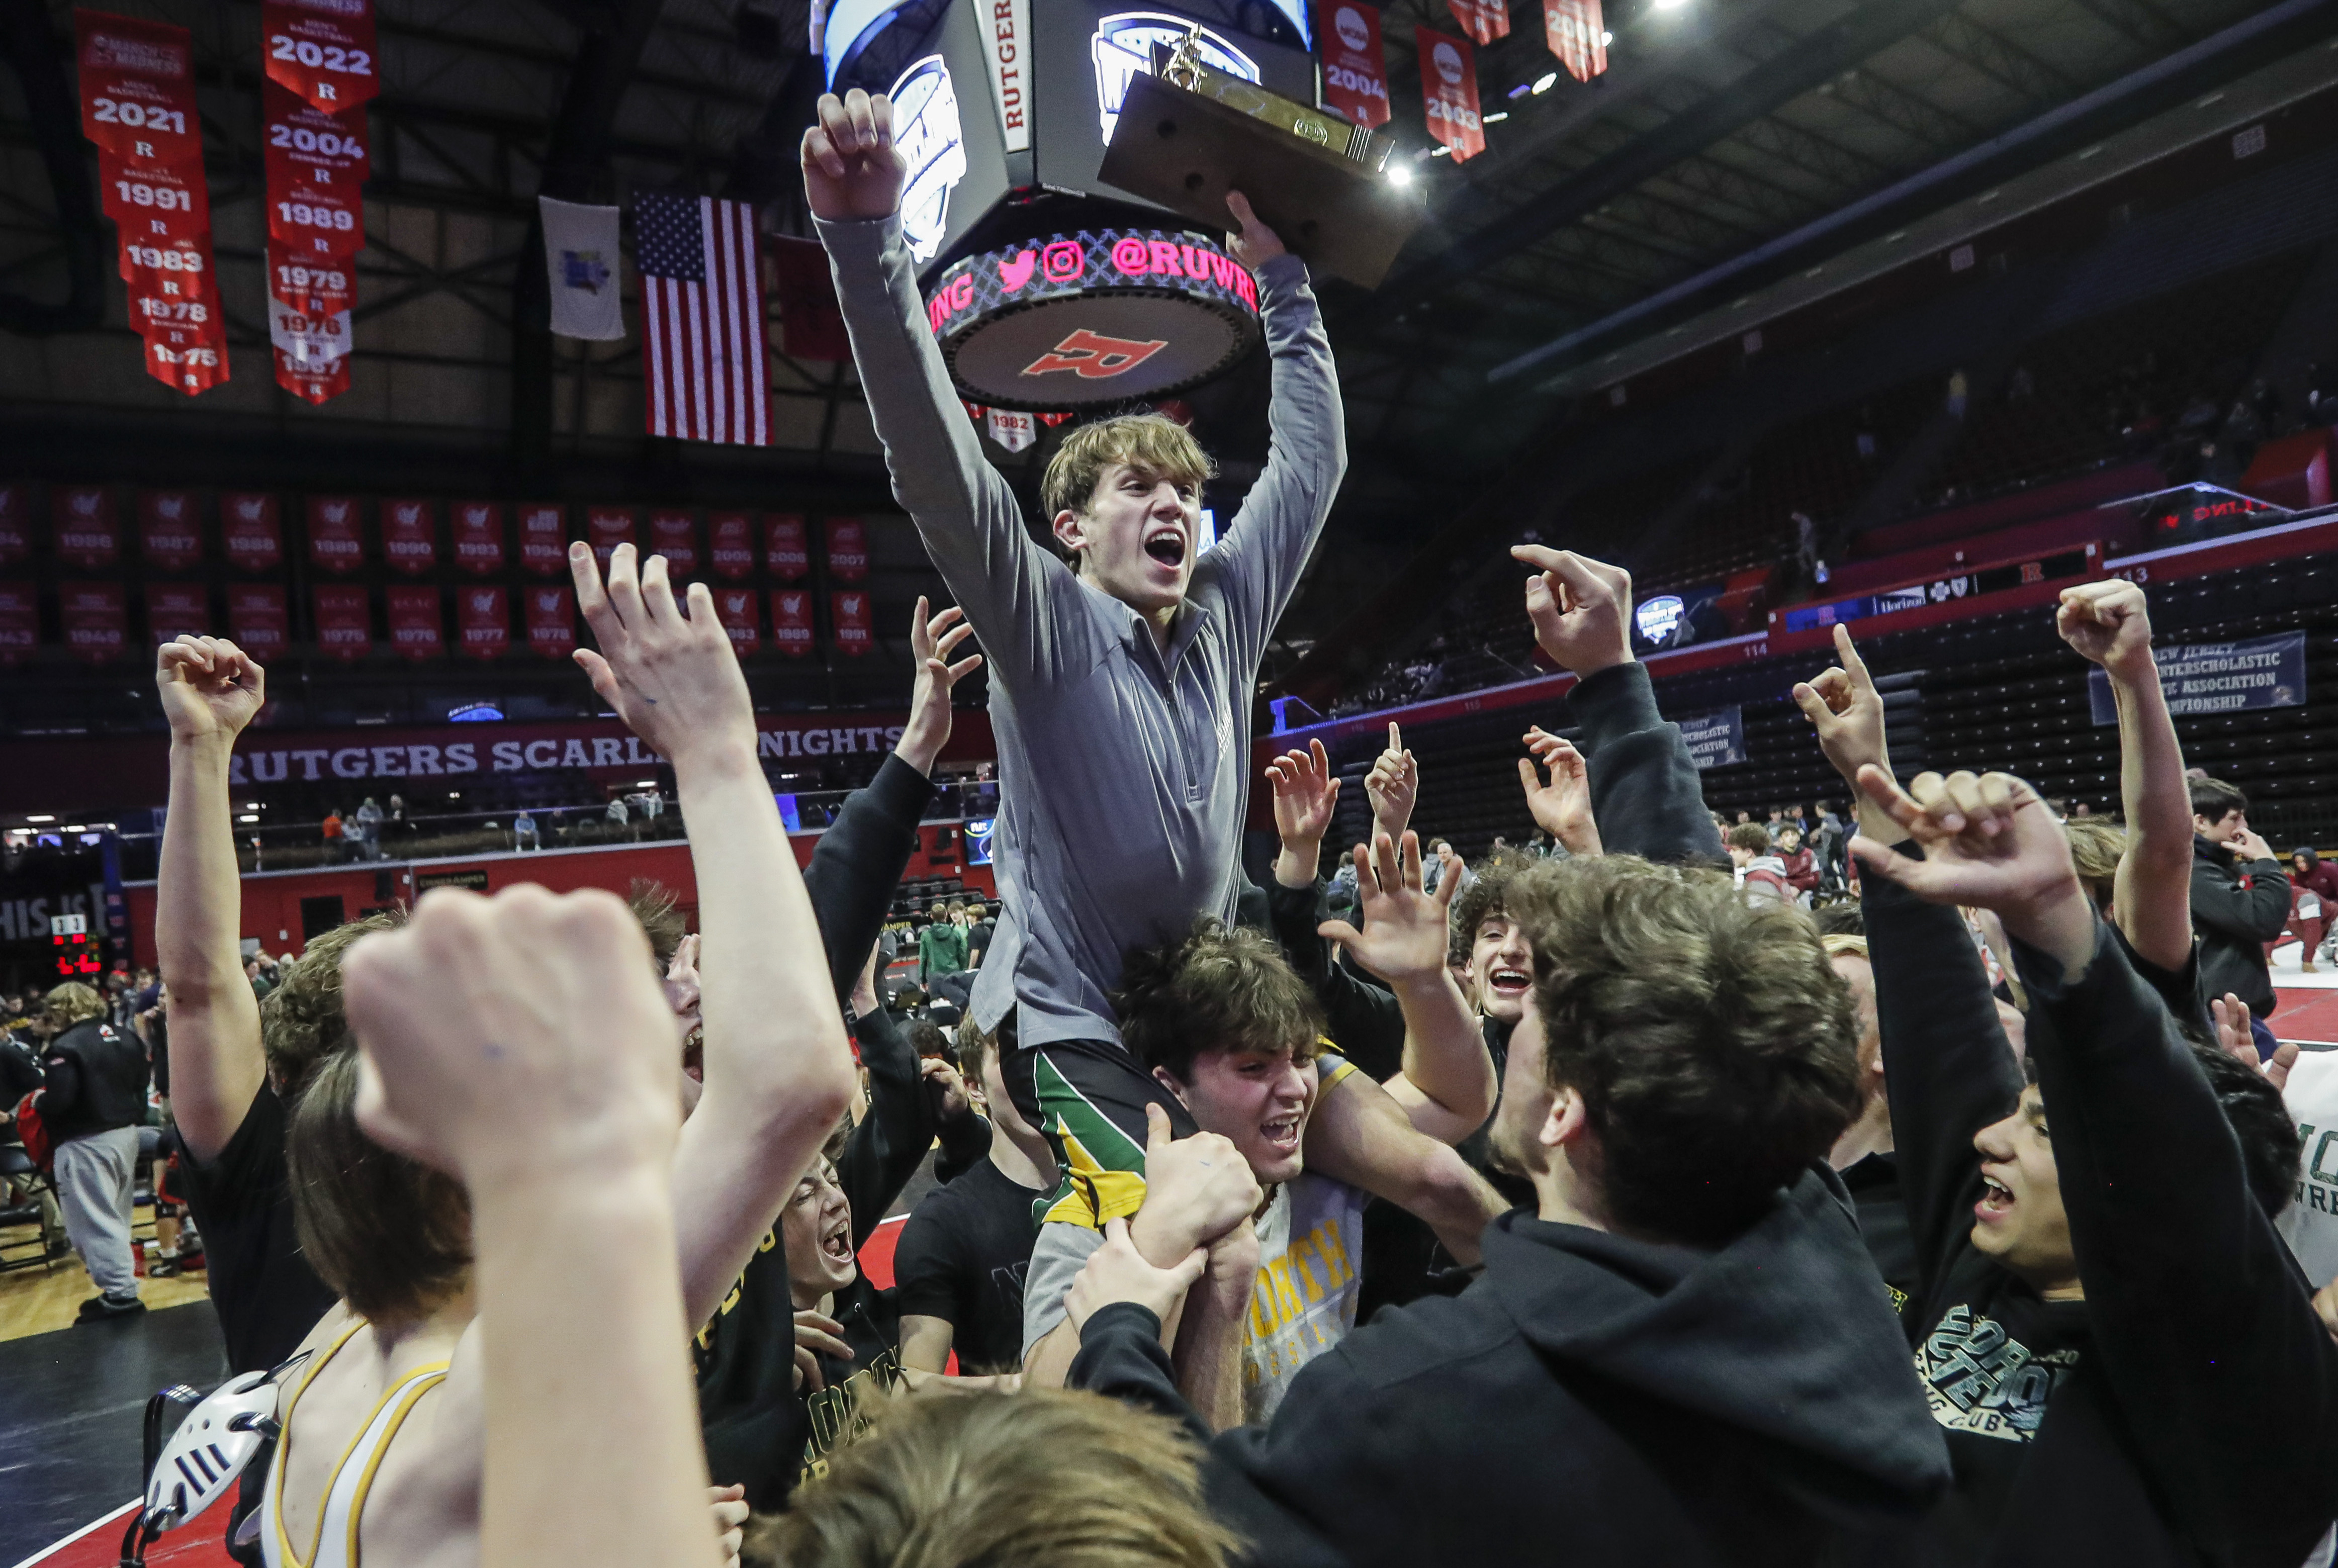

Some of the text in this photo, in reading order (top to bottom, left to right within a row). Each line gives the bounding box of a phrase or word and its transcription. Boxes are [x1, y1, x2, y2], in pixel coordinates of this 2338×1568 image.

[271, 34, 372, 76] 2022
[995, 0, 1024, 130] RUTGER
[318, 82, 337, 101] R
[1327, 64, 1387, 100] 2004
[93, 98, 185, 135] 2021
[135, 140, 155, 158] R
[270, 124, 365, 159] 2004
[115, 181, 191, 212] 1991
[151, 220, 168, 235] R
[278, 202, 353, 231] 1989
[127, 245, 204, 272] 1983
[278, 265, 347, 293] 1979
[138, 297, 207, 322] 1978
[928, 272, 974, 334] ING
[1019, 328, 1168, 378] R
[993, 415, 1029, 430] 1982
[2158, 652, 2281, 679] NTERSCHOLASTIC
[2182, 671, 2276, 694] ASSOCIATION
[230, 726, 907, 785] RUTGERS SCARL NIGHTS
[1244, 1218, 1355, 1346] ORTH
